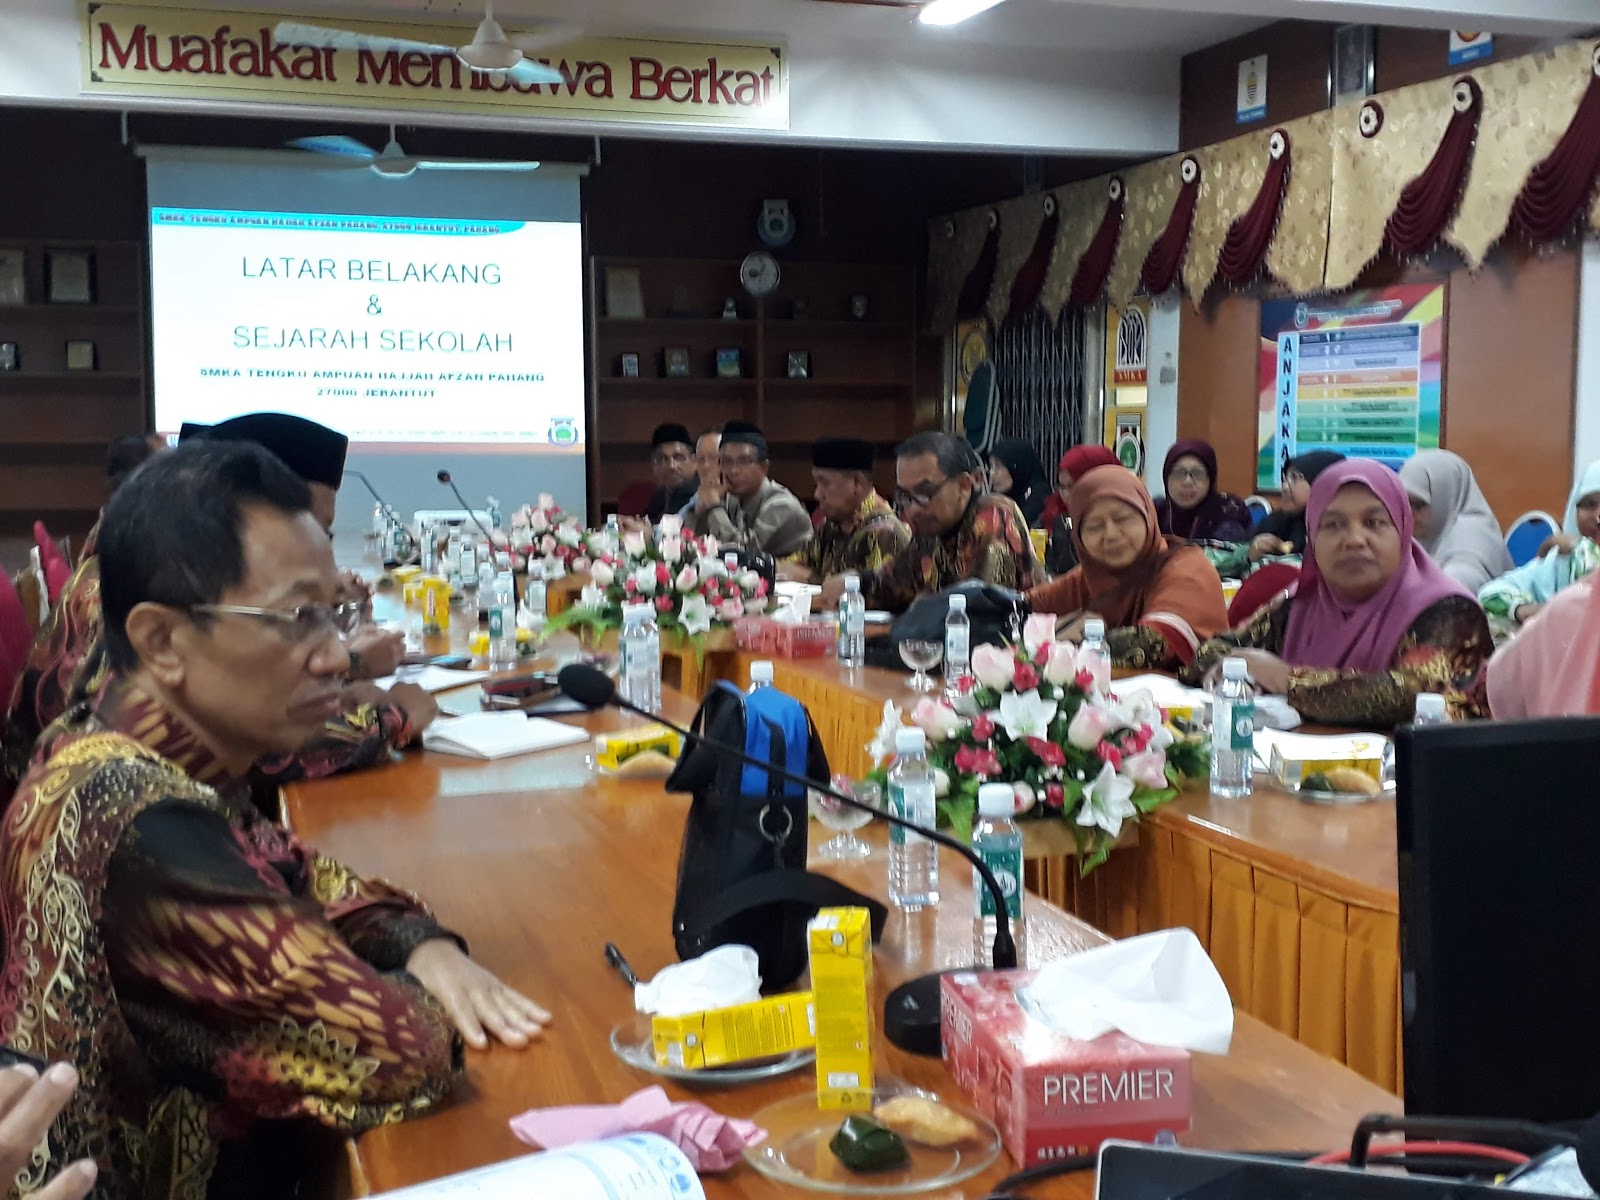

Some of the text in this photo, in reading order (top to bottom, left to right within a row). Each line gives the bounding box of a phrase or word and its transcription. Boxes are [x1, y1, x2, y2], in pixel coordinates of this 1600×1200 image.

[98, 21, 337, 82] Muafakat
[630, 56, 775, 108] Berkat
[242, 256, 502, 285] LATAR BELAKANG
[366, 294, 383, 316] &
[233, 325, 513, 353] SEJARAH SEKOLAH
[1043, 1068, 1175, 1106] PREMIER
